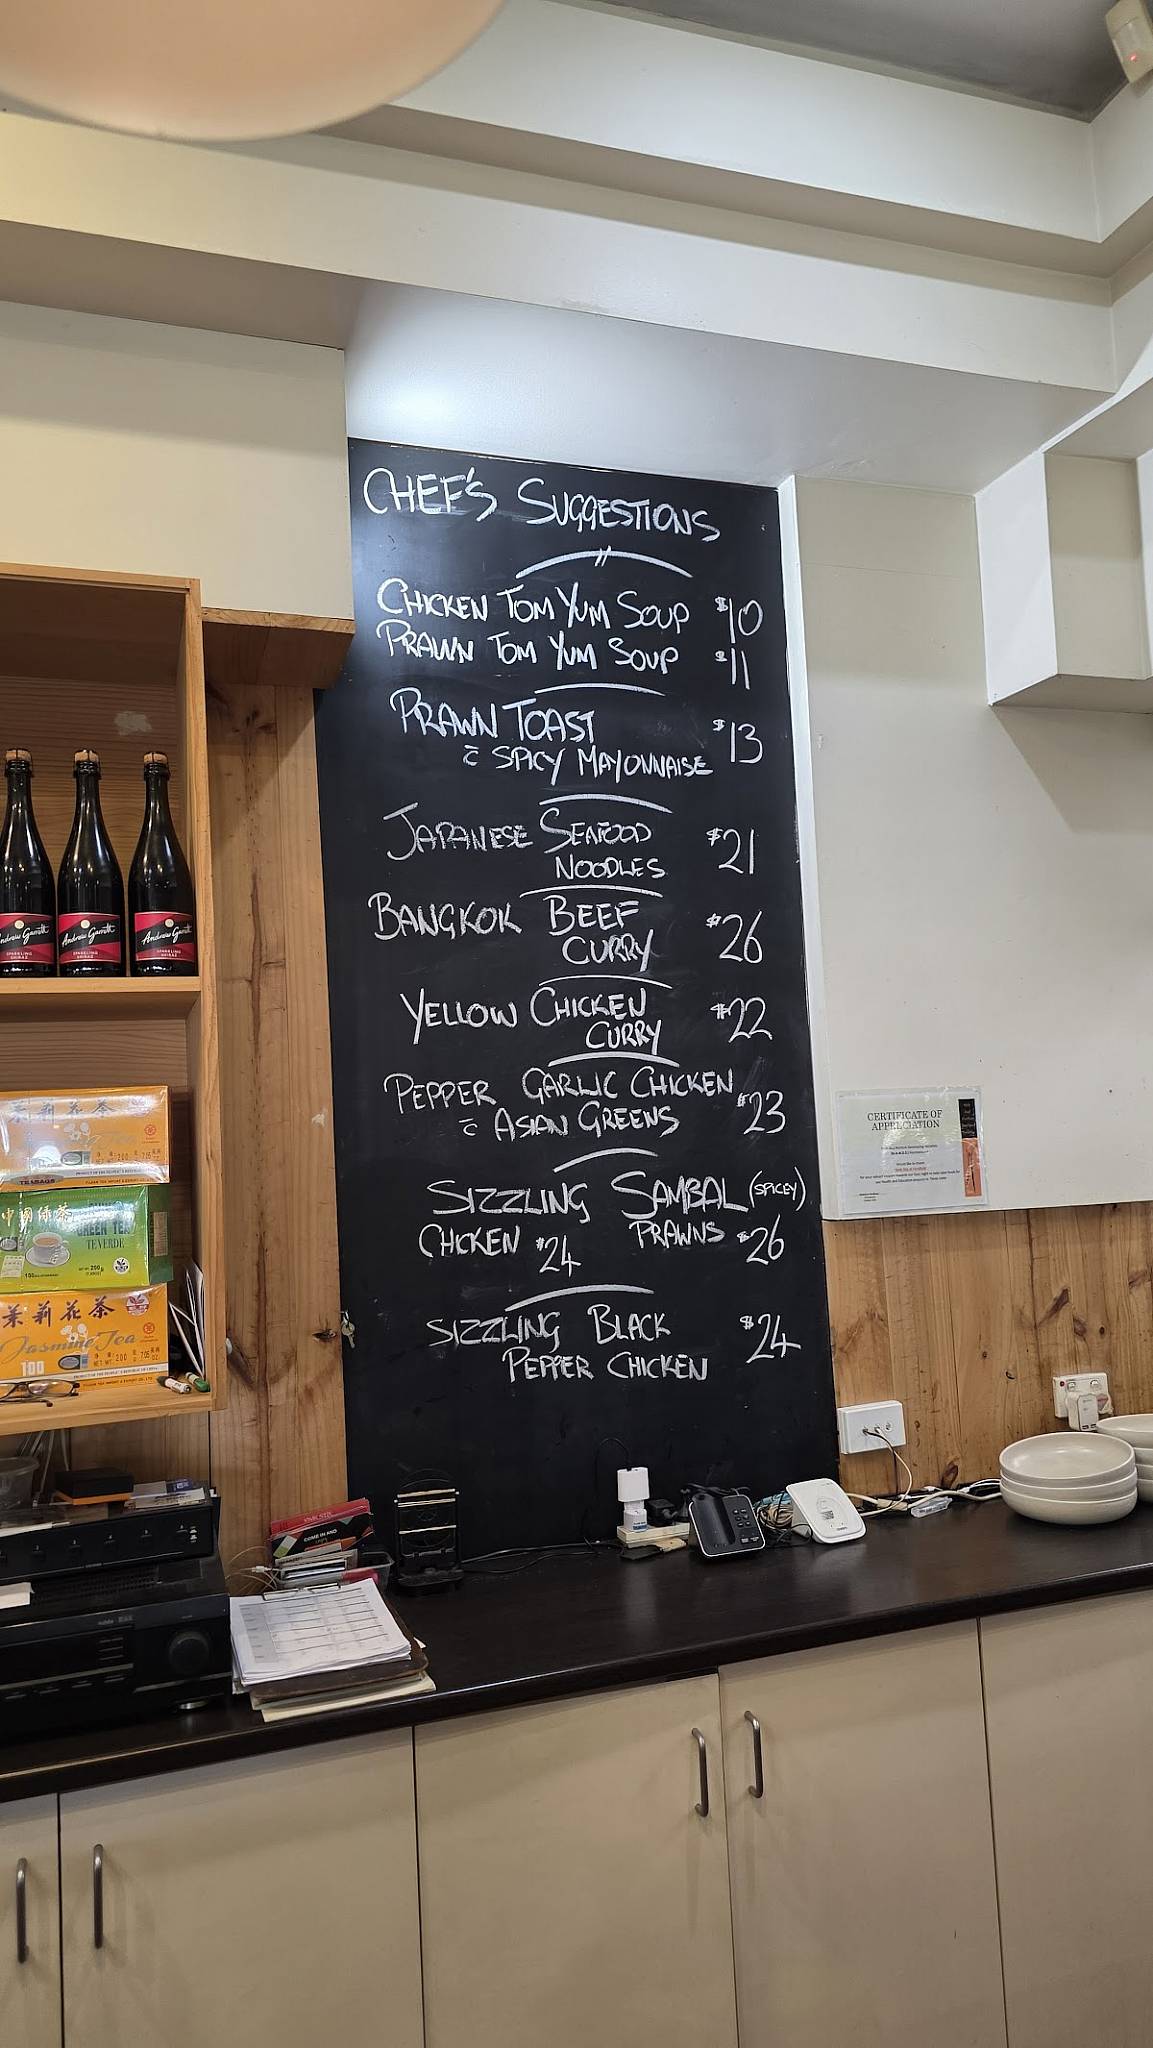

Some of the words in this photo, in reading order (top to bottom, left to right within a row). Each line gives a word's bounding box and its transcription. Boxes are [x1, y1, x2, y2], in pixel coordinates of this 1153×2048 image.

[364, 467, 498, 521] CHEF'S
[517, 477, 721, 542] SUGGESTIONS
[376, 578, 488, 622] CHICKEN
[496, 585, 555, 624] TOM
[556, 582, 611, 630] YUM
[616, 590, 690, 635] SOUP
[716, 596, 764, 644] $10
[376, 618, 475, 662] PRAWN
[487, 631, 537, 665] TOM
[548, 630, 598, 671] YUM
[608, 637, 680, 674] SOUP
[714, 649, 751, 690] $11
[389, 686, 499, 738] PRAWN
[501, 697, 595, 744] TOAST
[712, 718, 764, 765] $13
[491, 746, 568, 786] SPICY
[577, 747, 714, 783] MAYONNAISE
[383, 802, 533, 861] JAPANESE
[538, 807, 652, 854] SEAFOOD
[706, 827, 754, 875] $21
[555, 852, 666, 881] NOODLES
[62, 932, 88, 948] Andrew
[141, 931, 172, 946] Andrew
[367, 891, 522, 940] BANGKOK
[543, 894, 641, 937] BEEF
[705, 910, 764, 965] $26
[562, 928, 655, 973] CURRY
[400, 988, 518, 1045] YELLOW
[530, 987, 646, 1027] CHICKEN
[709, 997, 773, 1043] $22
[585, 1019, 662, 1055] CURRY
[383, 1073, 497, 1114] PEPPER
[521, 1066, 618, 1105] GARLIC
[630, 1065, 733, 1097] CHICKEN
[494, 1107, 568, 1142] ASIAN
[577, 1101, 681, 1138] GREENS
[736, 1091, 786, 1136] $23
[867, 1110, 929, 1121] CERTIFICATE
[930, 1109, 943, 1119] OF
[871, 1120, 941, 1131] APPRECIATION
[426, 1180, 591, 1224] SIZZLING
[610, 1170, 749, 1219] SAMBAL
[749, 1166, 807, 1212] (SPICEY)
[418, 1223, 520, 1258] CHICKEN
[535, 1235, 582, 1278] $24
[628, 1219, 726, 1249] PRAWNS
[737, 1214, 785, 1265] $26
[2, 1295, 115, 1329] 茉莉花茶
[426, 1310, 561, 1354] SIZZLING
[587, 1303, 672, 1345] BLACK
[740, 1313, 801, 1364] $24
[0, 1335, 94, 1365] Jasmine
[95, 1329, 137, 1351] Tea
[21, 1360, 45, 1377] 100
[115, 1353, 128, 1362] 200
[503, 1346, 595, 1383] PEPPER
[607, 1351, 708, 1381] CHICKEN
[303, 1533, 320, 1542] COME
